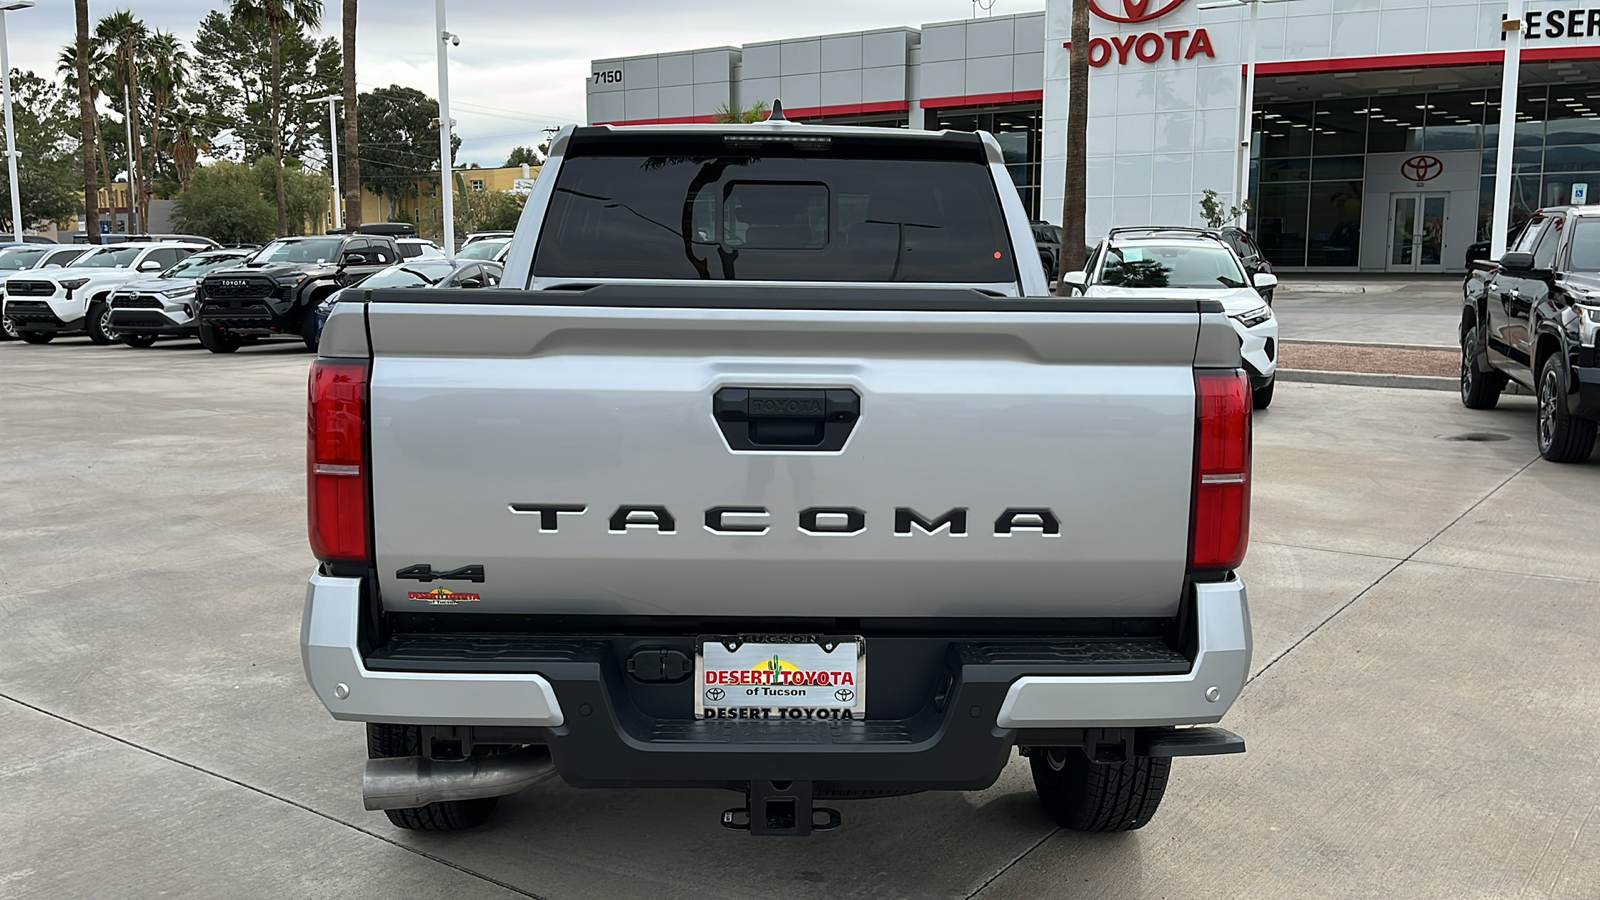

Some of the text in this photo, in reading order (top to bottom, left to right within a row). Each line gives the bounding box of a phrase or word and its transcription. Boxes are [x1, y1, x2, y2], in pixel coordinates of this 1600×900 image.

[1501, 9, 1600, 41] ESER
[1063, 28, 1215, 67] OYOTA
[593, 70, 622, 85] 7150
[753, 399, 822, 413] TOYOTA
[508, 503, 1062, 537] TACOMA
[741, 634, 817, 644] TUCSON
[705, 670, 854, 686] DESERT TOYOTA
[746, 687, 806, 696] of Tucson
[704, 708, 853, 719] DESERT TOYOTA
